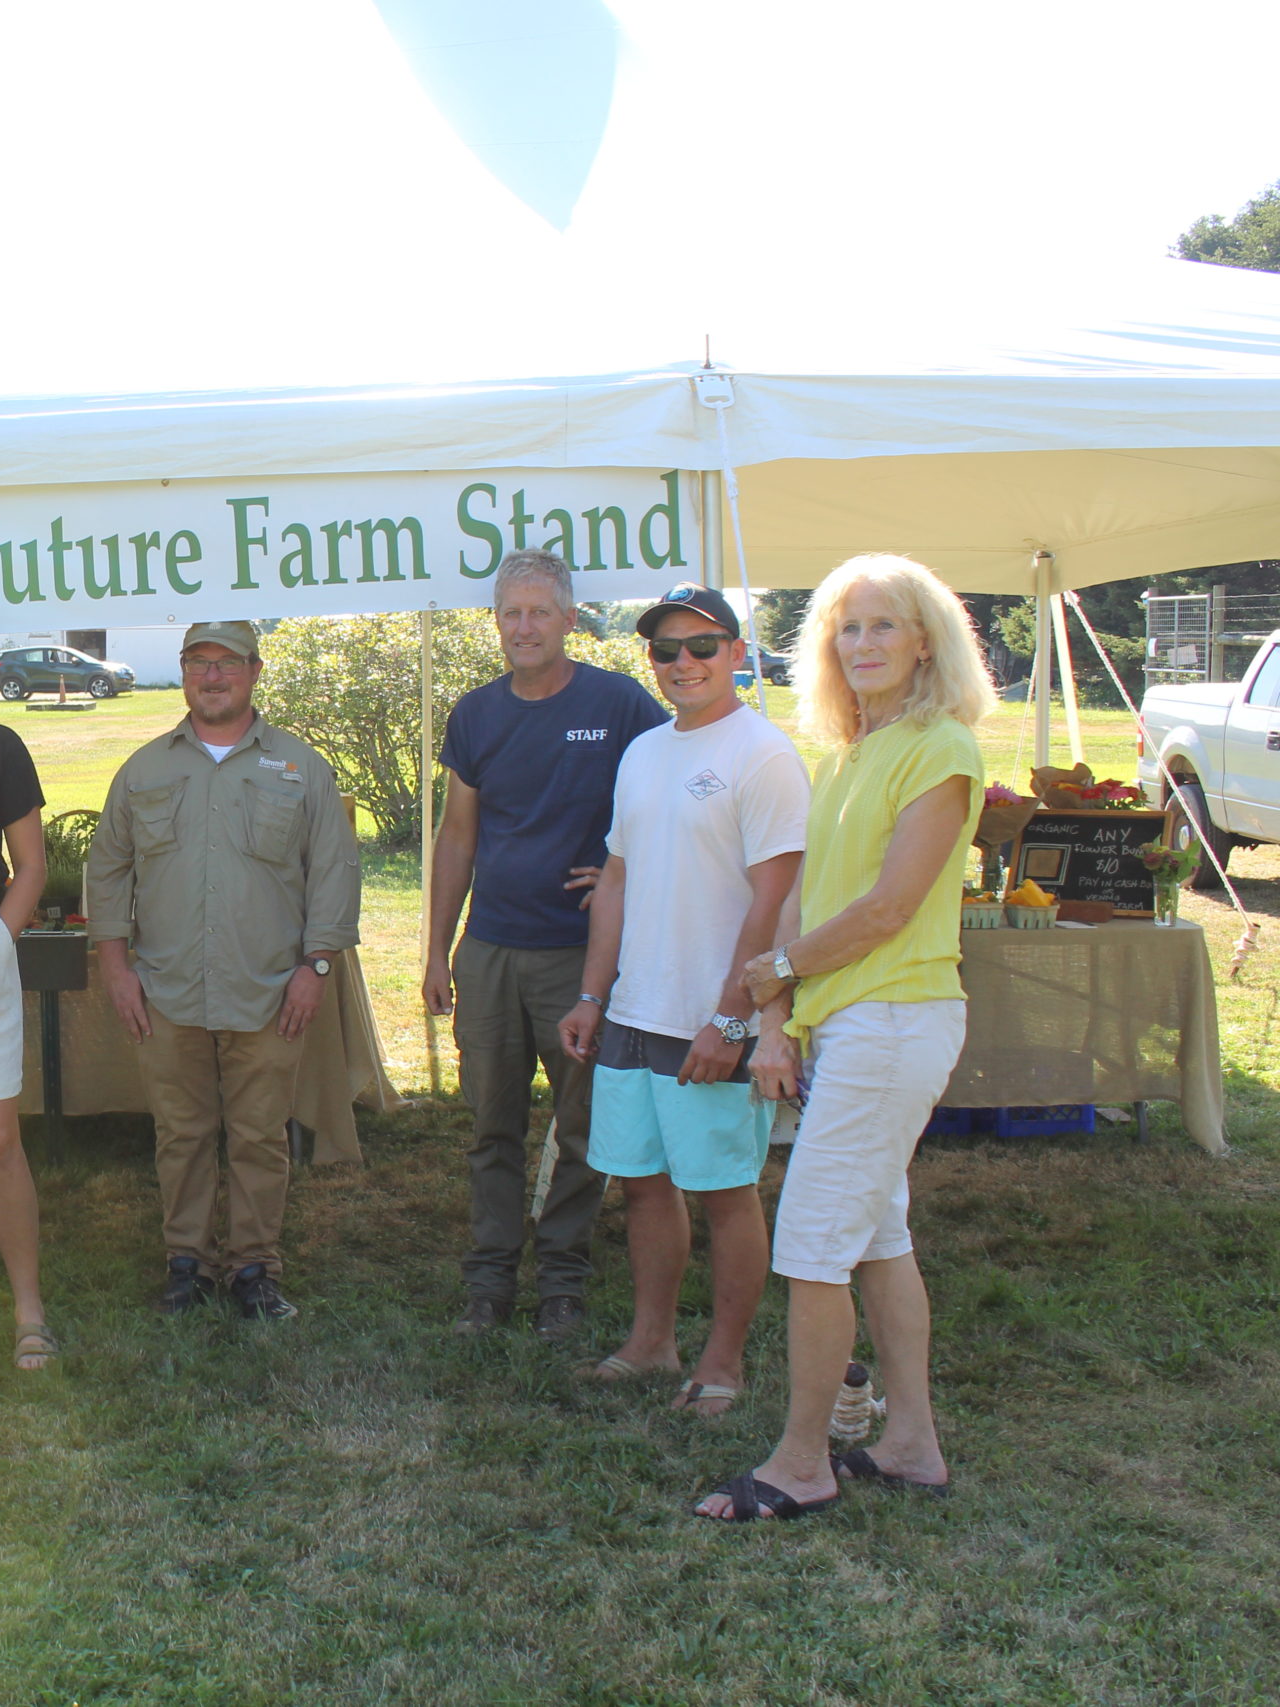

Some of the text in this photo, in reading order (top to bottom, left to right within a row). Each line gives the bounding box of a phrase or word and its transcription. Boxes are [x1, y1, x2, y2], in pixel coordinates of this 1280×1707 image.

[226, 496, 431, 588] Farm
[458, 470, 688, 579] Stand
[566, 729, 608, 741] STAFF
[259, 757, 287, 768] Summit
[1027, 823, 1080, 835] ORGANIC
[1093, 828, 1132, 843] ANY
[1096, 857, 1120, 875] $10
[1078, 876, 1100, 888] PAY
[1101, 880, 1112, 888] IN
[1114, 880, 1138, 888] CASH
